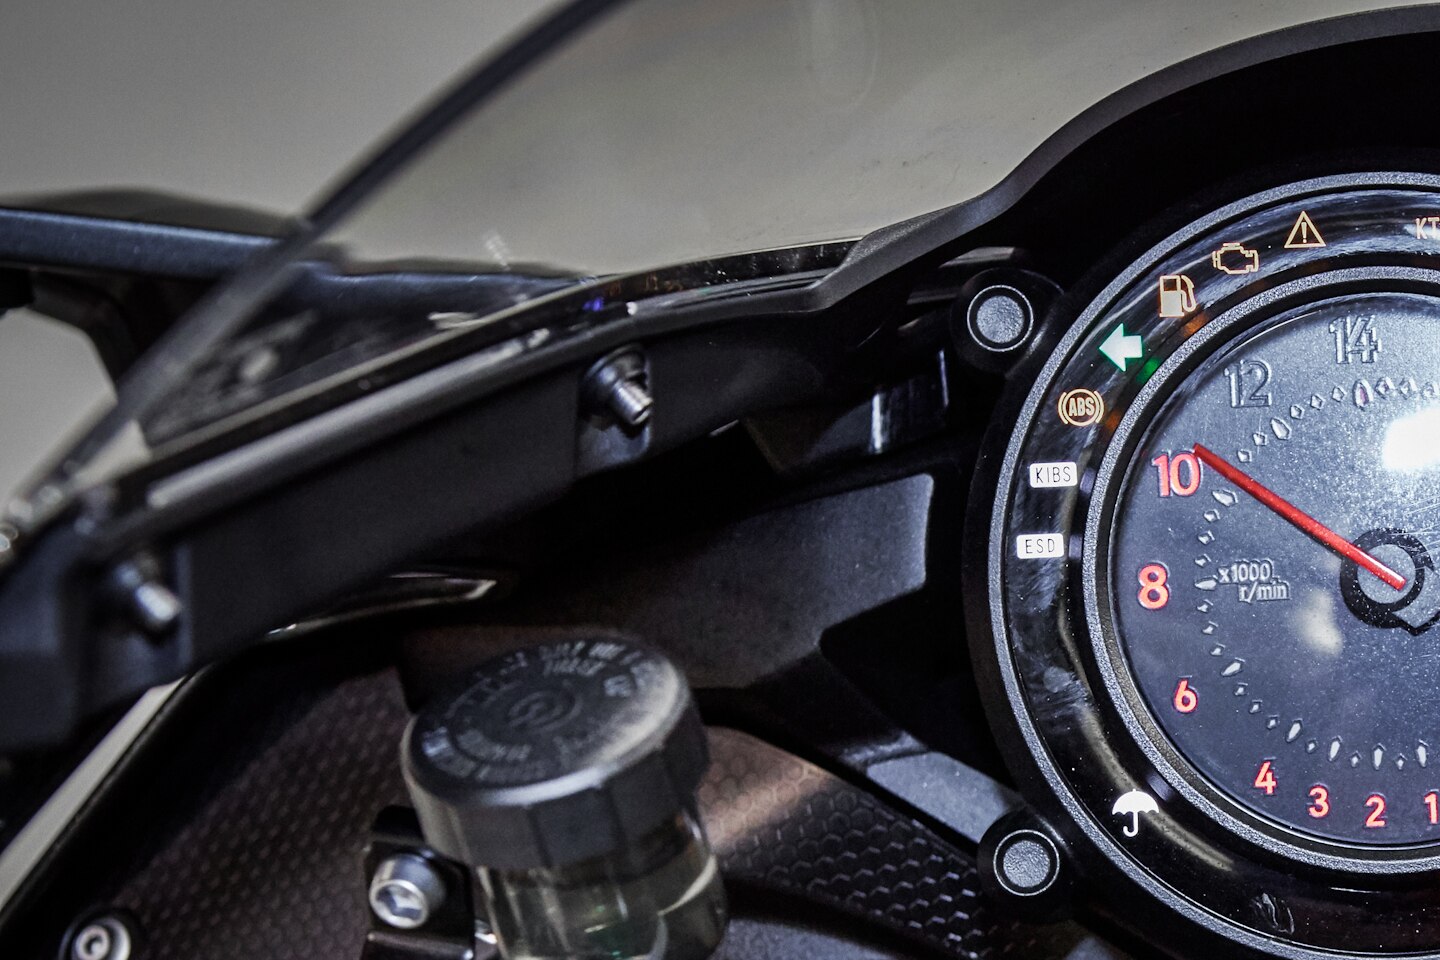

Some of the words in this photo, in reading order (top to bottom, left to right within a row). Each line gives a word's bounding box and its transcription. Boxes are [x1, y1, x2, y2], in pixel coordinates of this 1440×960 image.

[1329, 314, 1382, 364] 14
[1224, 359, 1272, 408] 12
[1068, 397, 1095, 417] ABS
[1035, 466, 1071, 484] KIBS
[1152, 450, 1201, 497] 10
[1025, 538, 1055, 554] ESD
[1137, 562, 1170, 610] 8
[1238, 580, 1291, 603] r/min
[1173, 678, 1198, 713] 6
[1254, 760, 1277, 795] 4
[1308, 785, 1330, 818] 3
[1364, 794, 1387, 828] 2
[1423, 791, 1439, 824] 1
